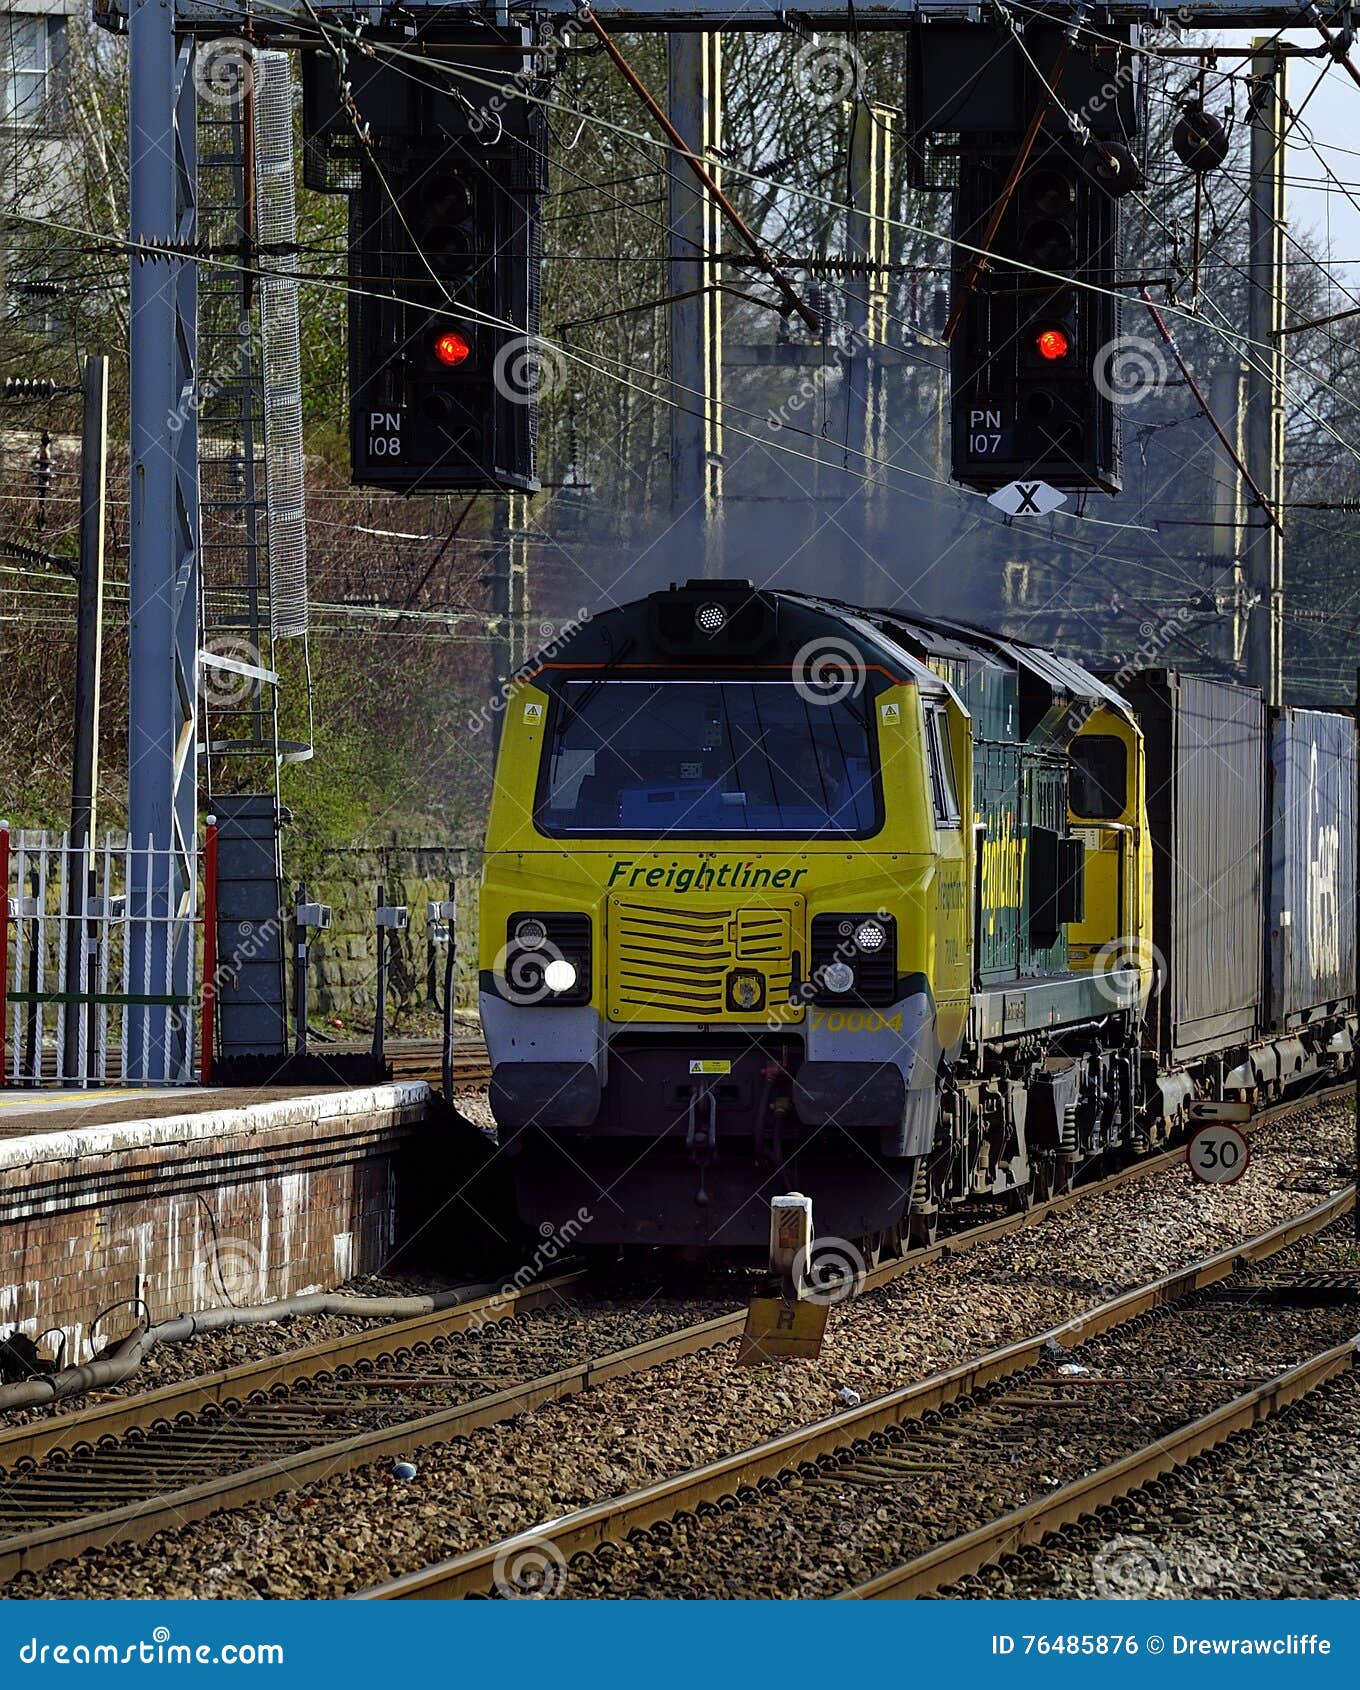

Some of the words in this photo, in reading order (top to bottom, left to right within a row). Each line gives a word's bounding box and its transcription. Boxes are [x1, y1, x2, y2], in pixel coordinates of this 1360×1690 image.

[370, 412, 401, 431] PN
[969, 410, 1001, 429] PN
[369, 436, 401, 456] 108
[969, 434, 1002, 454] 107
[607, 861, 808, 893] Freightliner
[811, 1010, 904, 1032] 70004
[1199, 1140, 1239, 1169] 30
[776, 1309, 796, 1330] R
